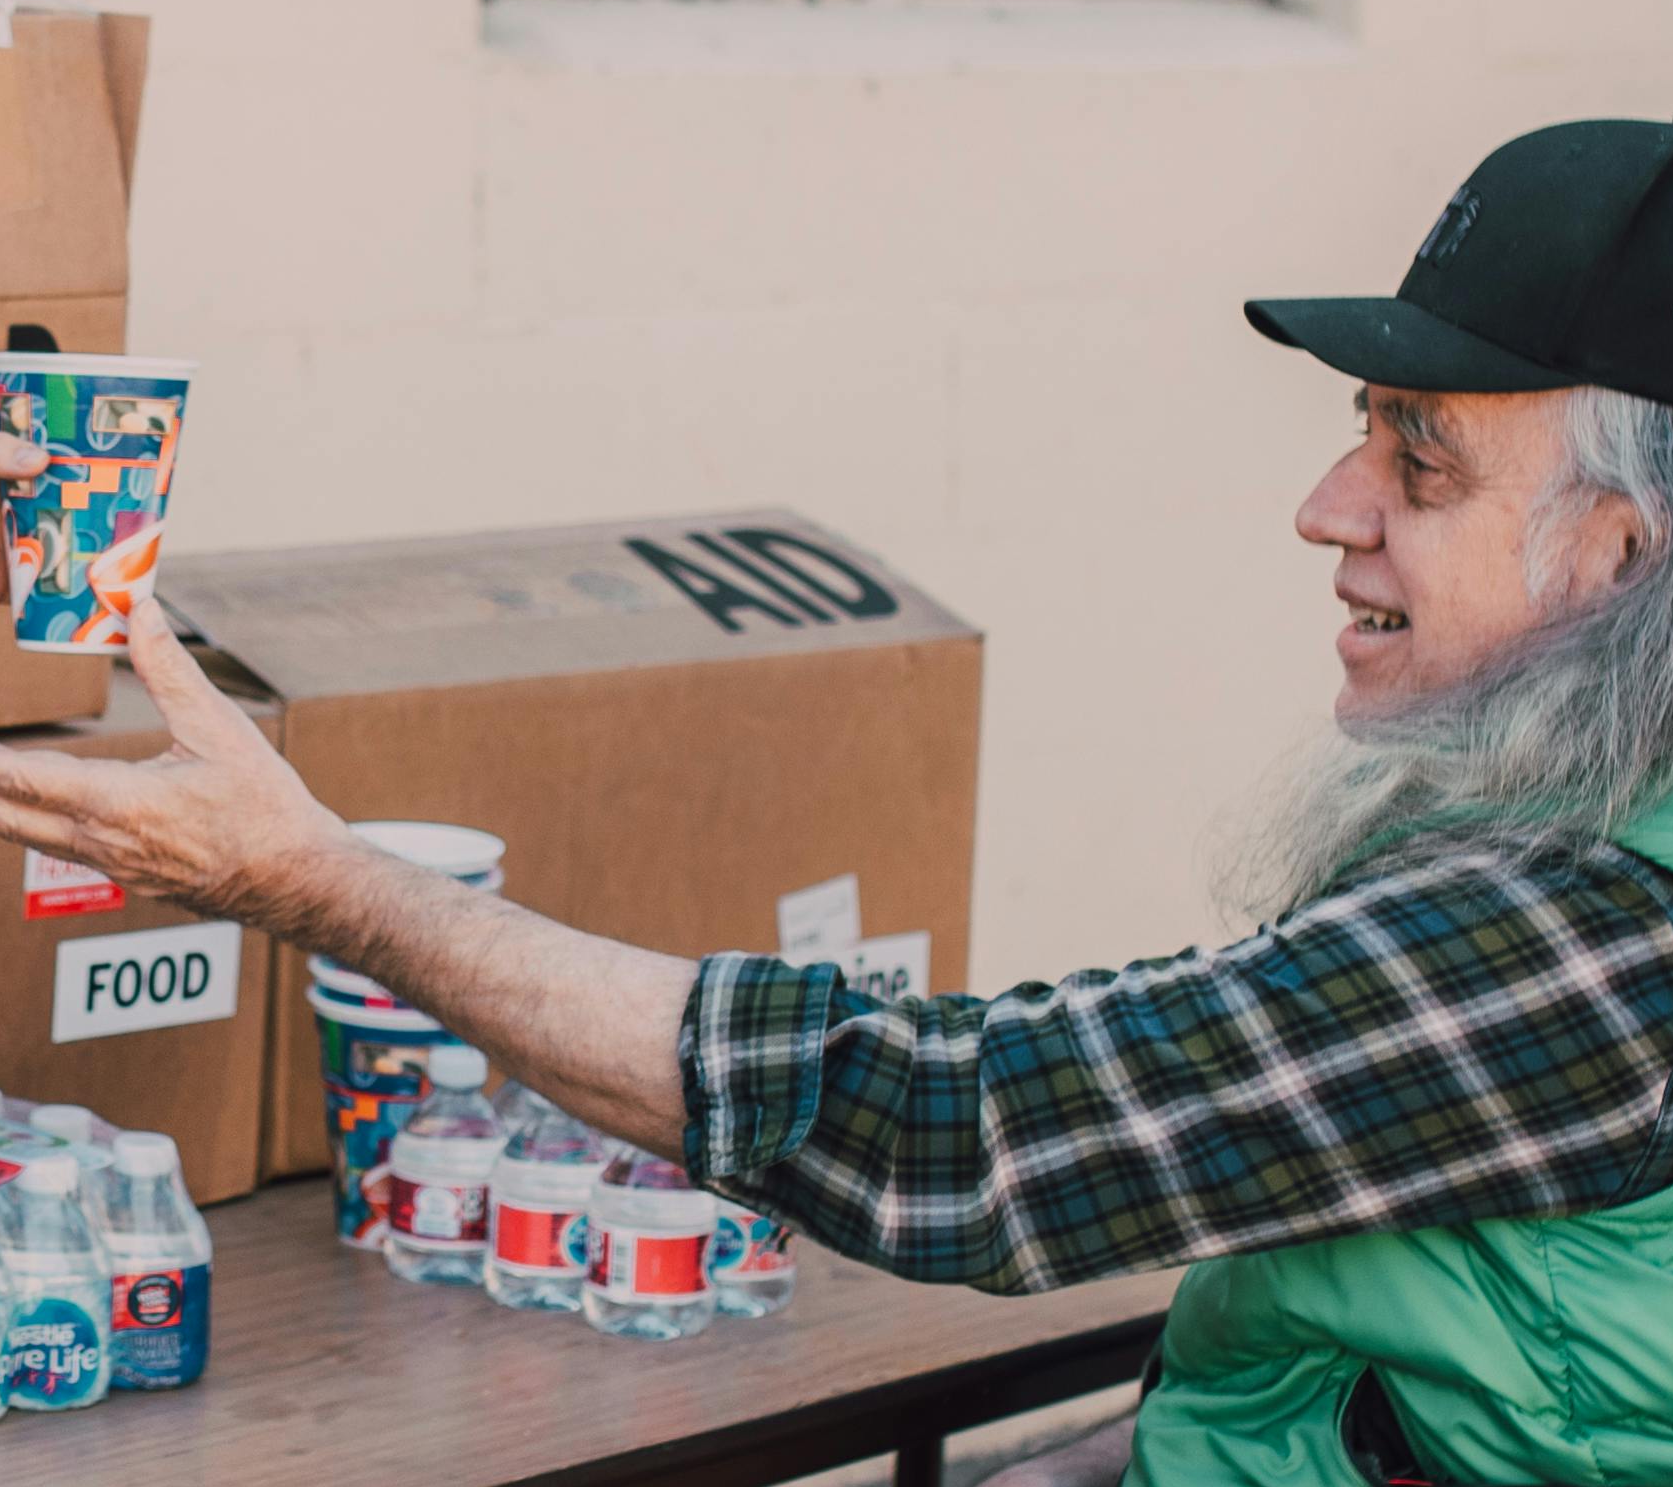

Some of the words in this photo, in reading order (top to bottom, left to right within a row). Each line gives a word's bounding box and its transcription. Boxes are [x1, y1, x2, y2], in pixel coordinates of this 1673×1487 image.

[621, 527, 898, 634] AID
[86, 952, 210, 1013] FOOD
[49, 1344, 99, 1384] Life
